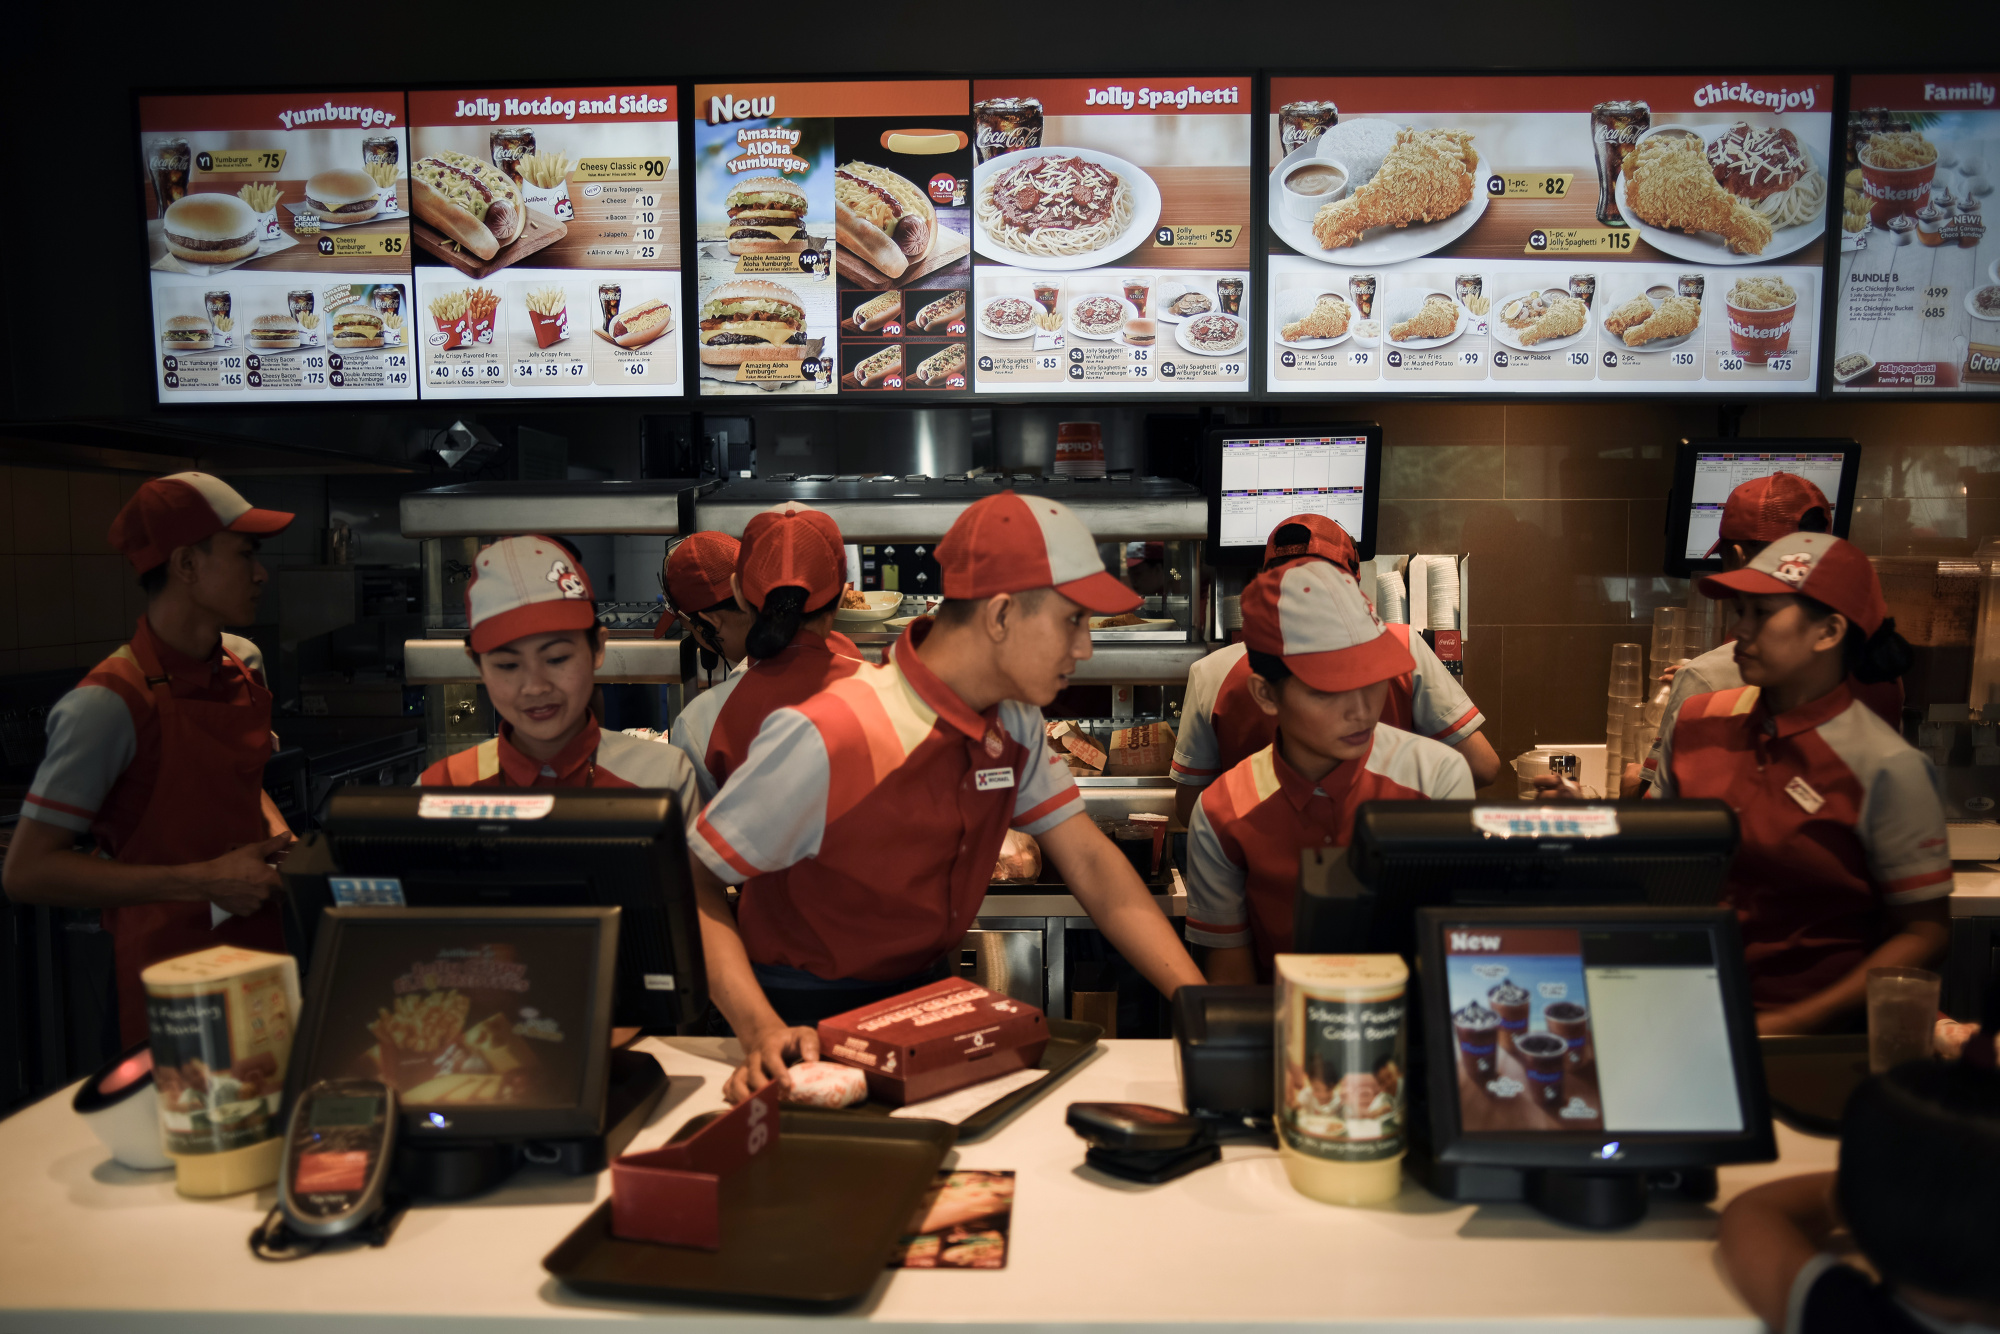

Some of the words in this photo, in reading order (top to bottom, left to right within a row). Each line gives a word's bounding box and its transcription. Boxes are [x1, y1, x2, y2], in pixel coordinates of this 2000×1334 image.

[1086, 87, 1135, 109] Jolly
[1137, 86, 1238, 109] Spaghetti
[1694, 82, 1815, 113] Chickenjoy
[1924, 82, 1995, 105] Family
[455, 98, 500, 121] Jolly
[504, 97, 576, 119] Hotdog
[579, 95, 616, 114] and
[620, 95, 667, 113] Sides
[710, 94, 776, 123] New
[278, 102, 396, 129] Yumburger
[737, 128, 800, 144] Amazing
[200, 156, 210, 167] Y1
[215, 156, 248, 165] Yumburger
[726, 155, 809, 173] Yumburger
[580, 163, 608, 173] Cheesy
[610, 162, 637, 170] Classic
[1489, 180, 1501, 191] C1
[524, 196, 547, 204] Jollibee
[1953, 215, 1980, 224] NEW!
[1159, 232, 1171, 241] S1
[1177, 227, 1192, 235] Jolly
[1177, 233, 1207, 242] Spaghetti
[320, 240, 332, 250] Y2
[336, 237, 356, 246] Cheesy
[1530, 235, 1544, 245] C3
[1549, 239, 1564, 247] Jolly
[1565, 238, 1597, 247] Spaghetti
[615, 249, 623, 257] Any
[1852, 274, 1890, 282] BUNDLE
[1893, 274, 1898, 282] B
[745, 363, 771, 371] Amazing
[994, 358, 1005, 366] Jolly
[1007, 357, 1033, 366] Spaghetti
[1190, 364, 1216, 372] Spaghetti
[1879, 365, 1898, 373] Jolly
[1898, 365, 1936, 373] Spaghetti
[1450, 932, 1502, 951] New
